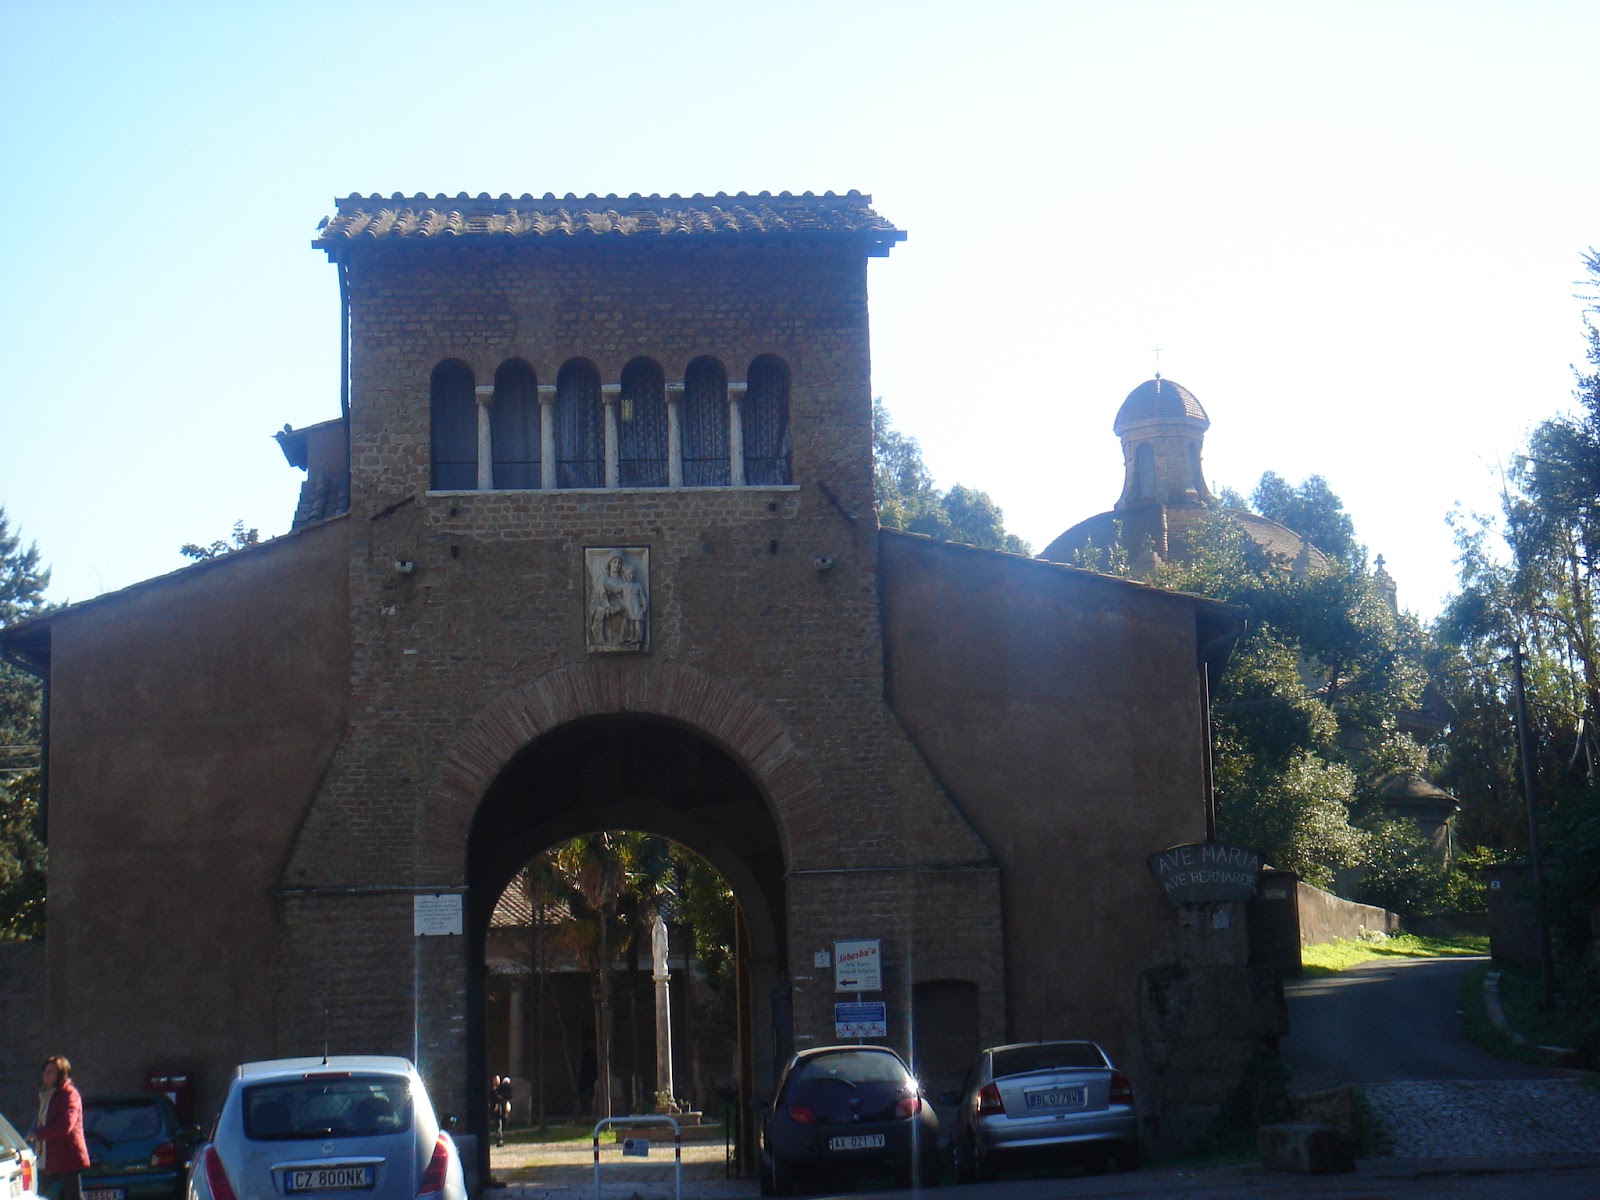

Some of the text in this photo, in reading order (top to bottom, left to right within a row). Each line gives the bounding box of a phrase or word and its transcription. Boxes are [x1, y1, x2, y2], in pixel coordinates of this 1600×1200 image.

[1159, 846, 1259, 875] AVE MARIA
[1164, 873, 1187, 893] AVE
[835, 1135, 884, 1148] AX 021 TV
[295, 1169, 364, 1188] CZ 800NK
